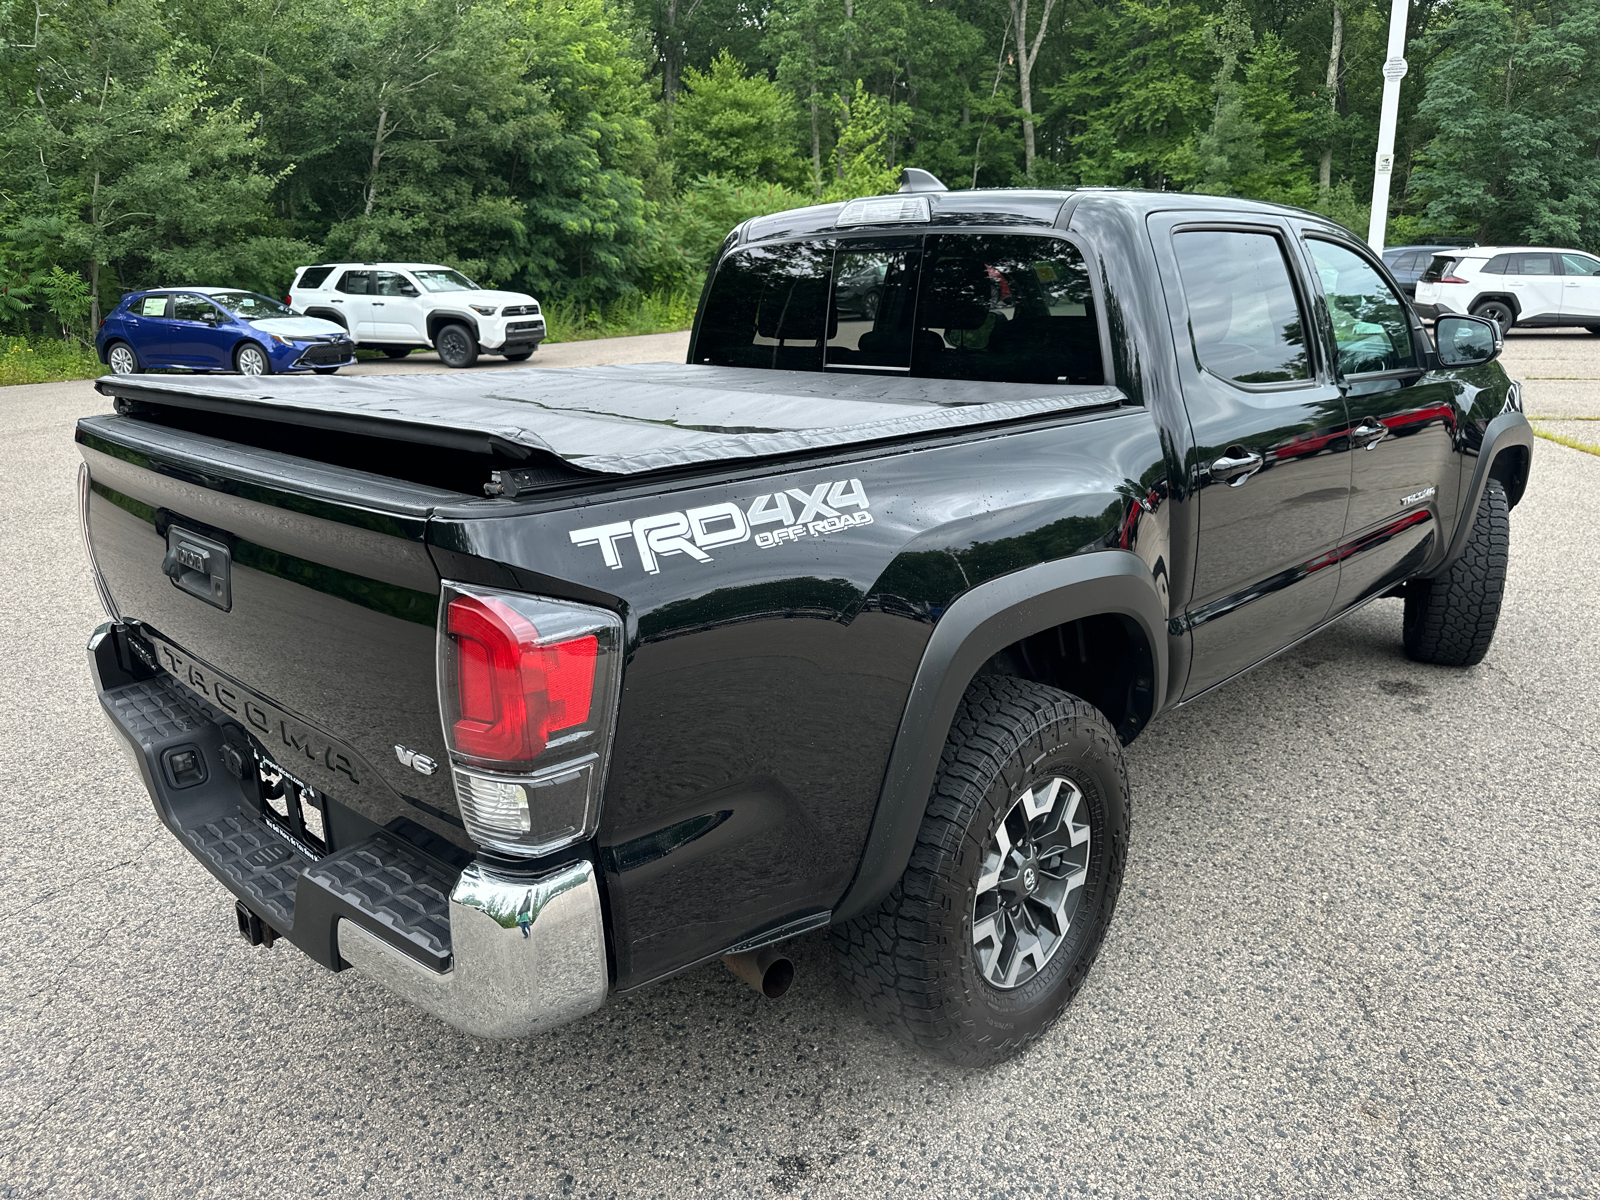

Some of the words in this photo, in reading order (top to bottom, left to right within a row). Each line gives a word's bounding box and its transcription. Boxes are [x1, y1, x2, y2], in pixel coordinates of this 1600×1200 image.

[1401, 486, 1436, 506] TACOMA
[569, 502, 751, 575] TRD
[755, 525, 807, 549] OFF
[807, 511, 874, 537] ROAD
[163, 645, 360, 785] TACOMA
[394, 743, 439, 776] V6
